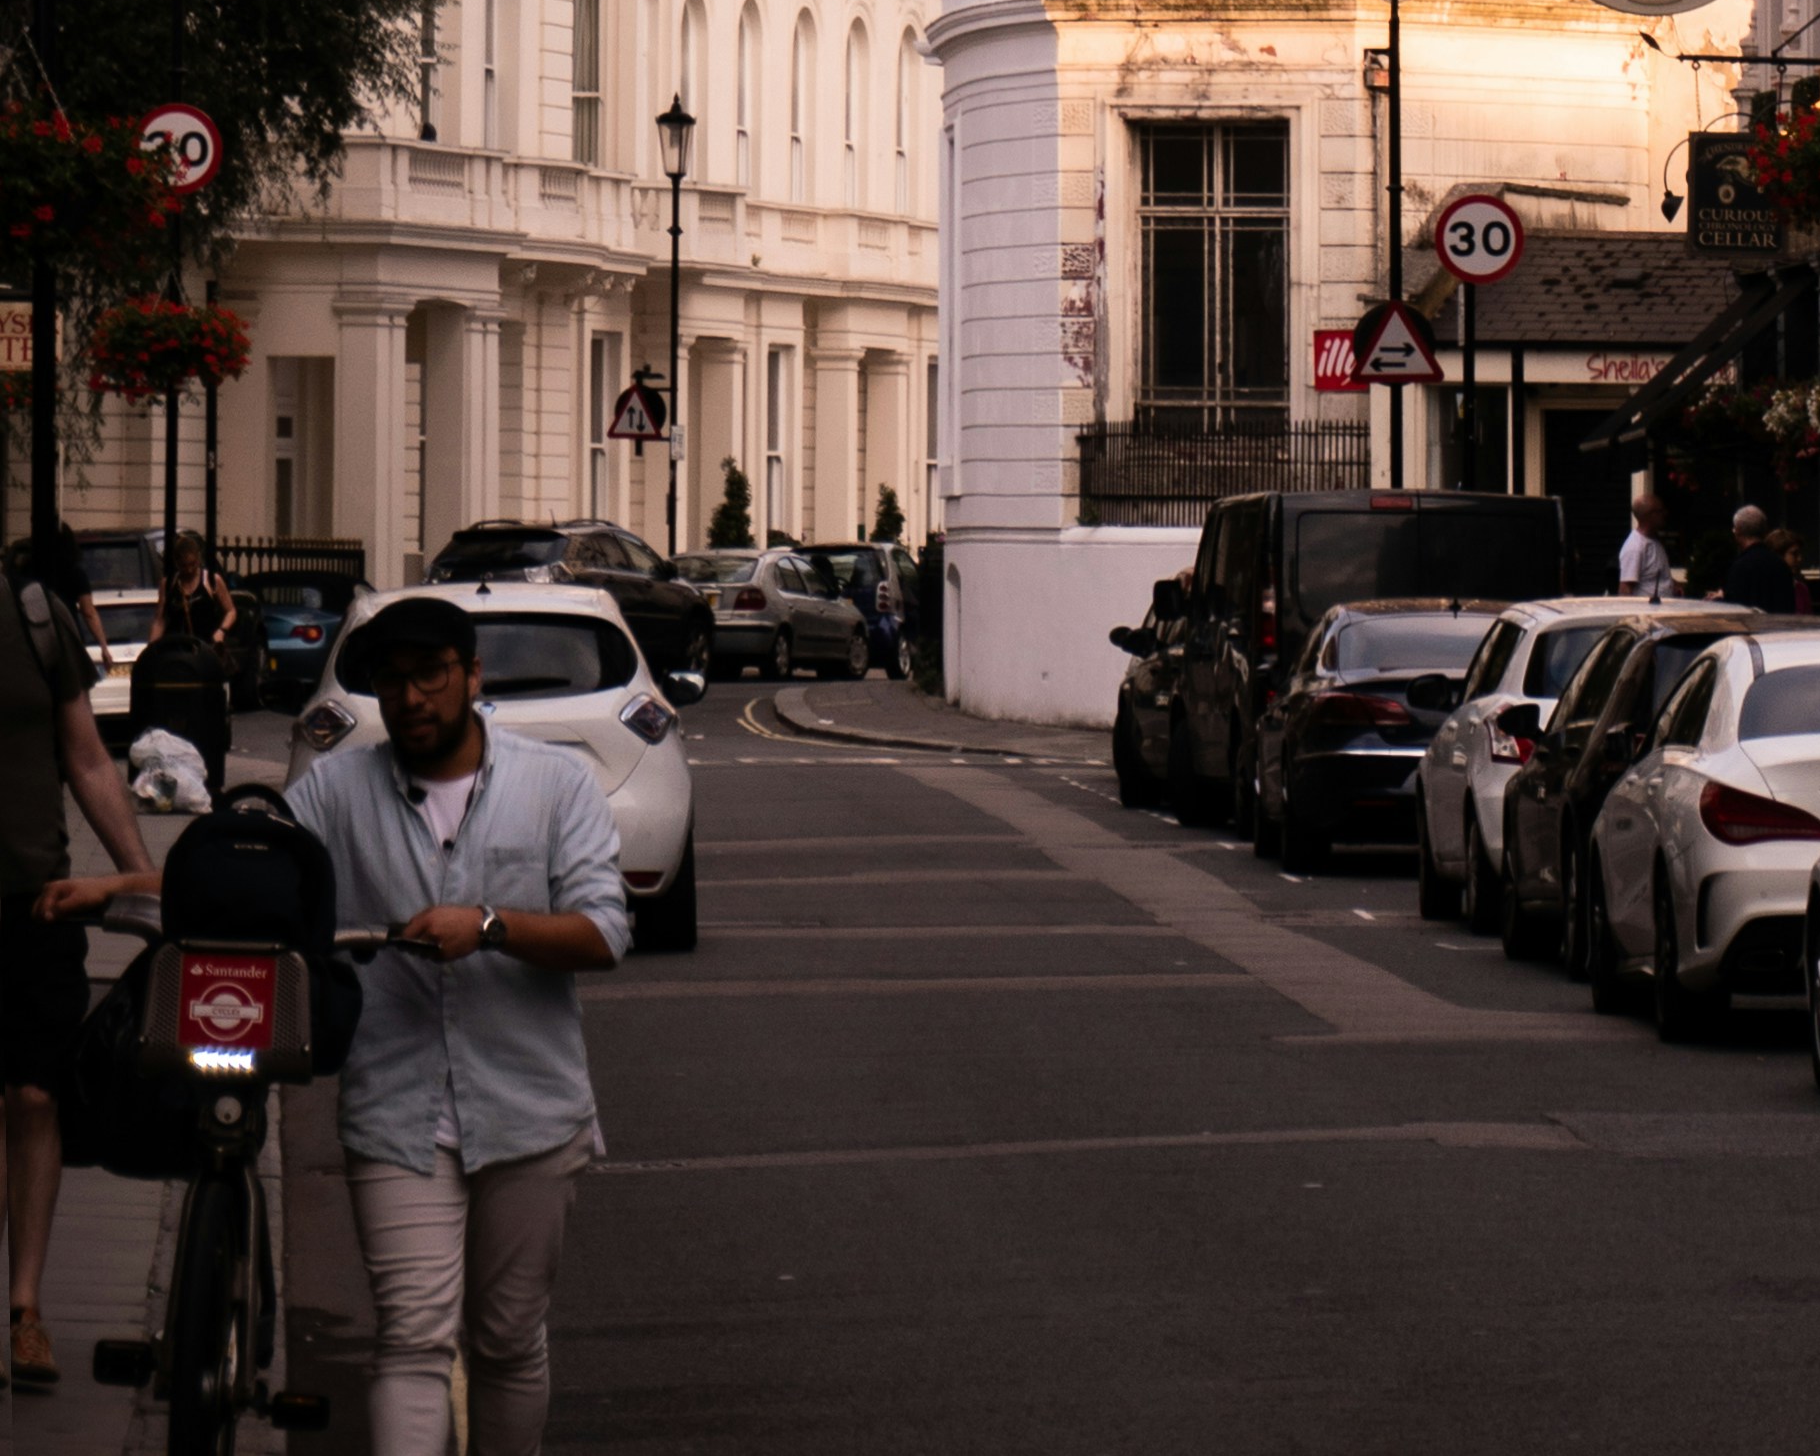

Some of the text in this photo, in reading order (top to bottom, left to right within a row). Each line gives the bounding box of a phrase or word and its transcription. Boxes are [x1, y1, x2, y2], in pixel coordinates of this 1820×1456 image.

[1698, 207, 1778, 223] CURIOUS
[1449, 221, 1511, 257] 30
[1698, 231, 1778, 248] CELLAR
[205, 962, 268, 980] Santander
